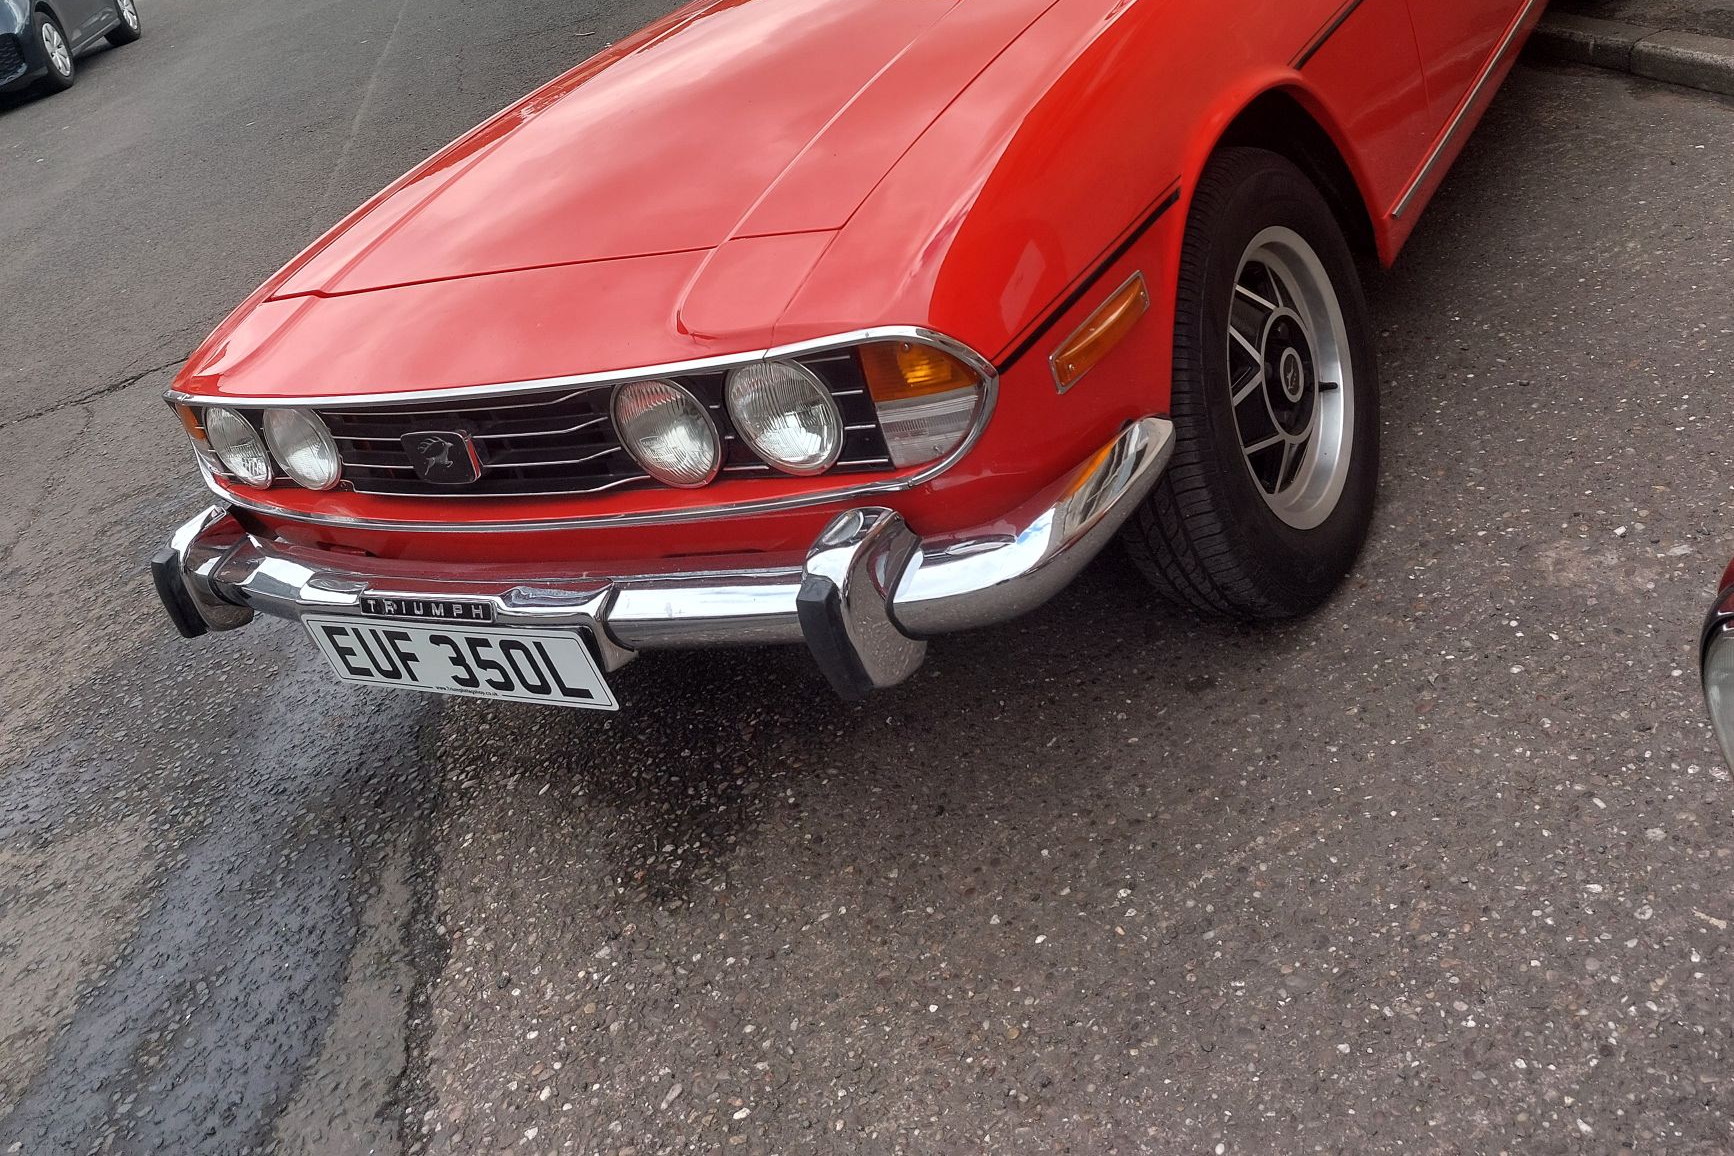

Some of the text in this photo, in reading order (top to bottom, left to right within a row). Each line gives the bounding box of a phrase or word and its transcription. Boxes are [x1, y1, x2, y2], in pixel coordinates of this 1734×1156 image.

[366, 599, 484, 619] TRIUMPH
[321, 625, 594, 700] EUF 350L
